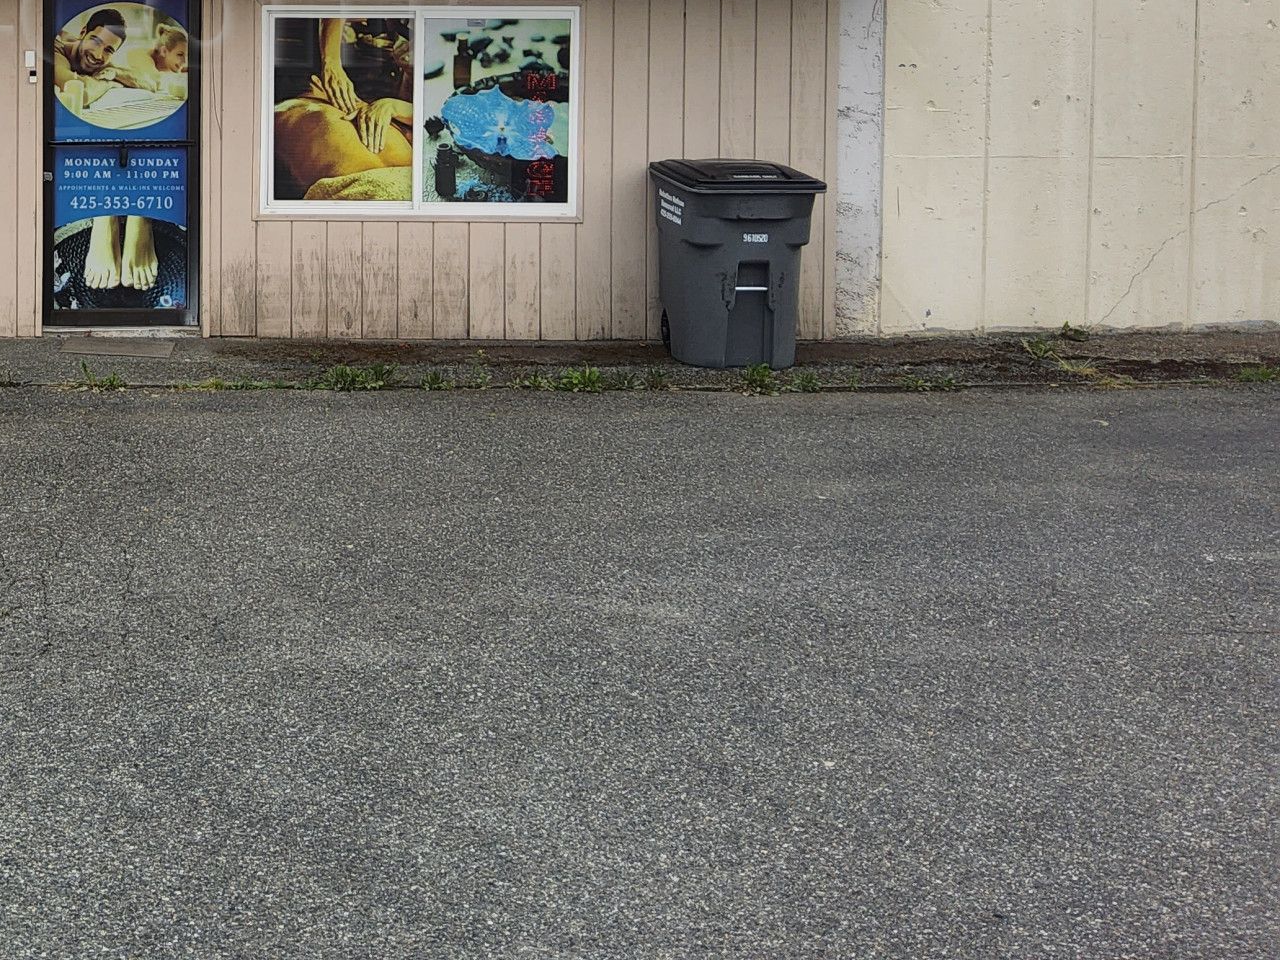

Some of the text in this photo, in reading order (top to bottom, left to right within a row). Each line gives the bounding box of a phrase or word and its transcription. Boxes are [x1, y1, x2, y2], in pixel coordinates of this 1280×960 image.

[64, 158, 179, 167] MONDAY SUNDAY
[64, 170, 89, 178] 9:00
[93, 170, 112, 178] AM
[126, 170, 157, 178] 11:00
[162, 170, 179, 178] PM
[70, 196, 173, 209] 425-353-6710
